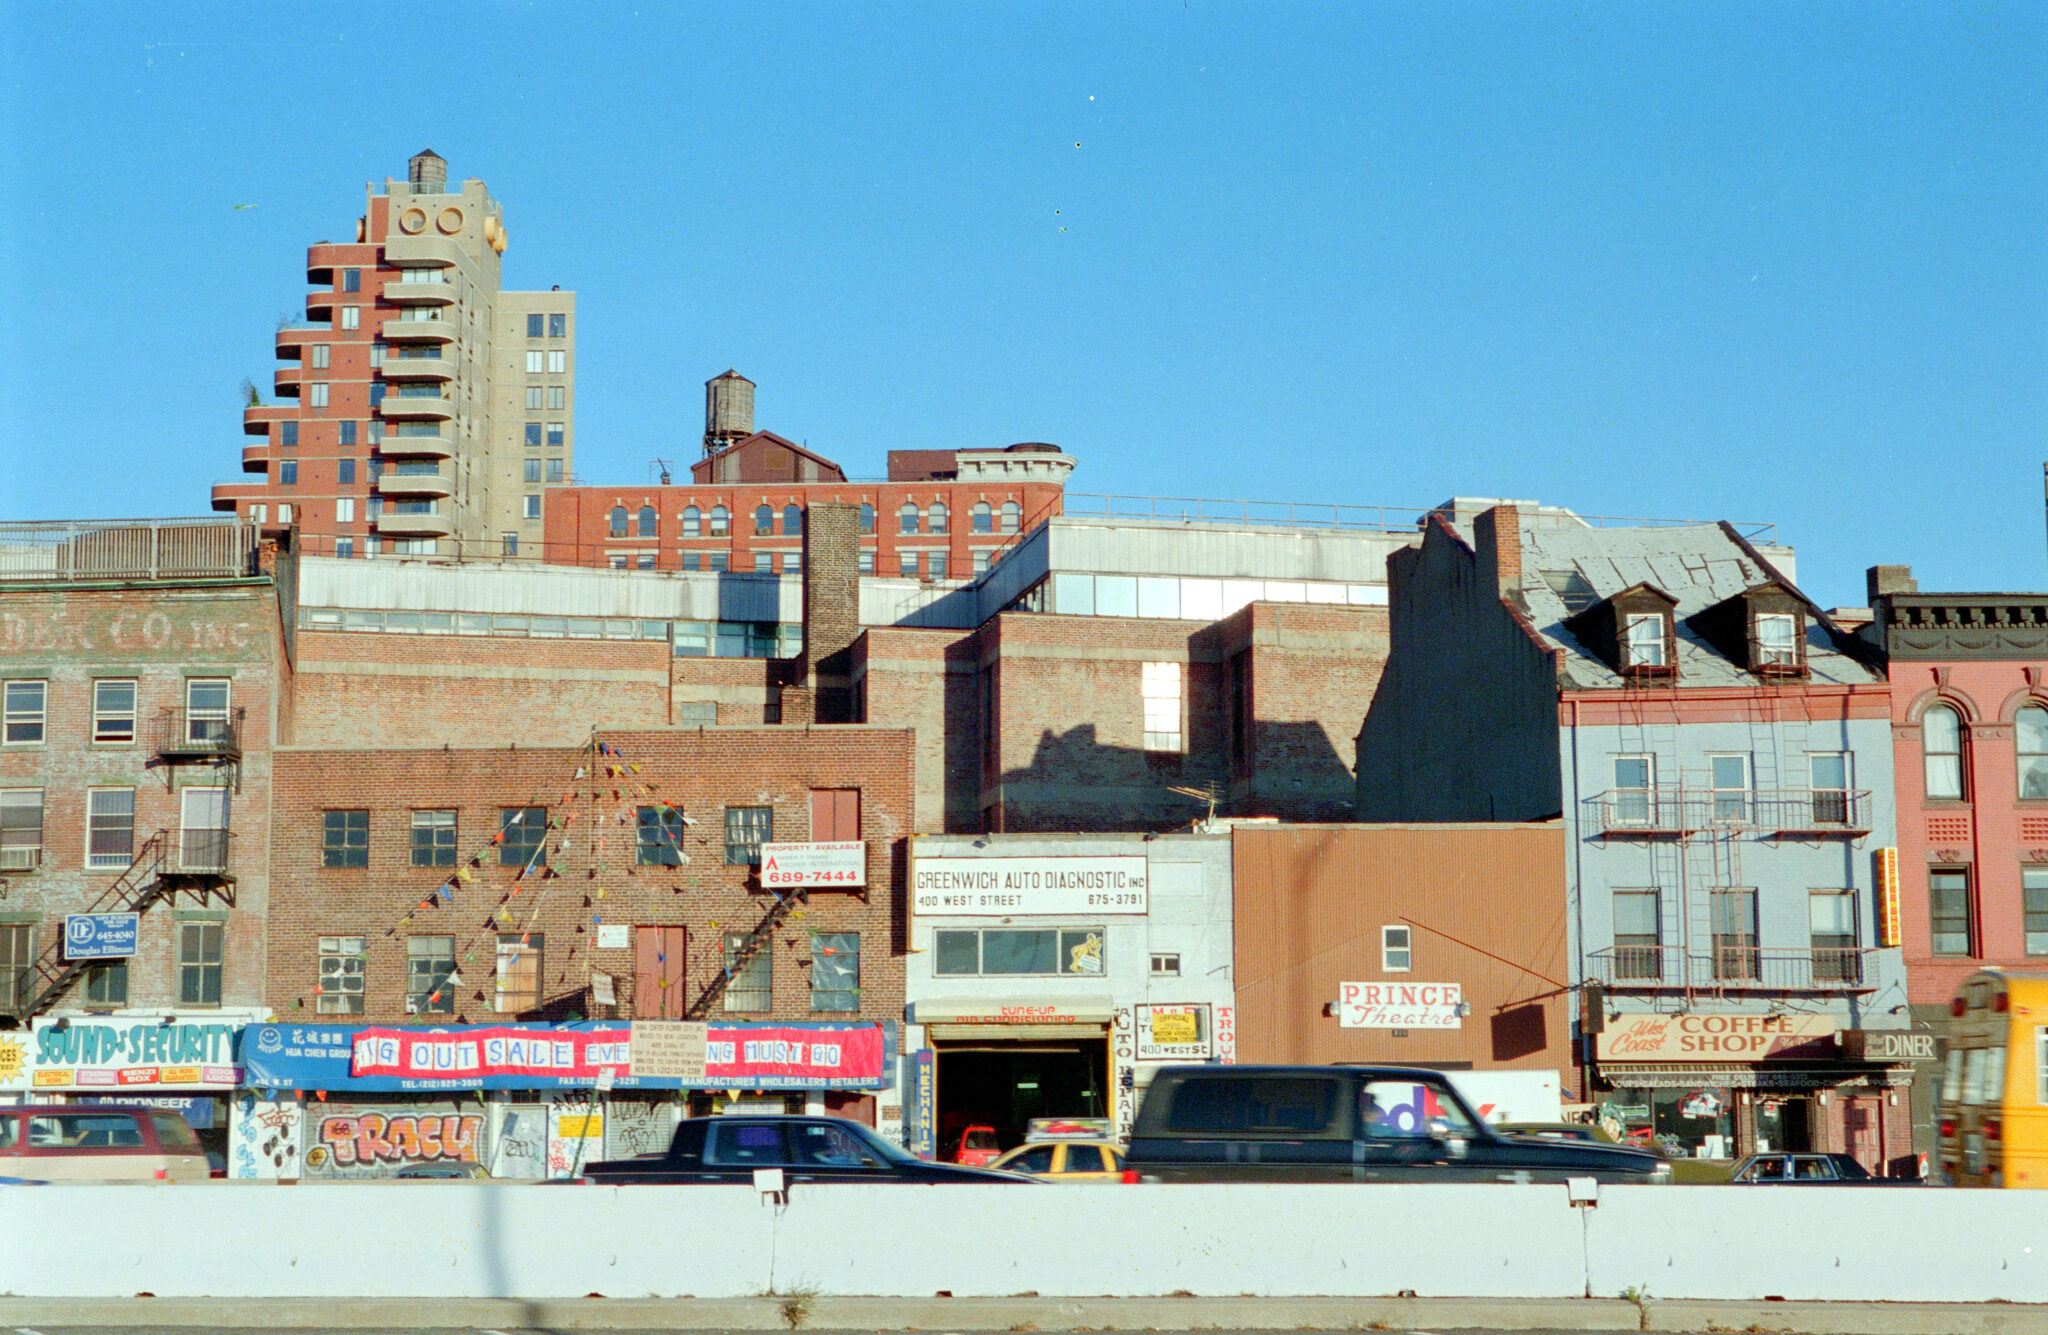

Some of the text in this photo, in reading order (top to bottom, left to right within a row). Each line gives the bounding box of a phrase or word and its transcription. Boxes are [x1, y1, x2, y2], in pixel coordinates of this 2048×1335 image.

[769, 870, 857, 883] 689-7444
[917, 871, 1145, 889] GREENWICH AUTO DIAGNOSTIC INC
[918, 894, 1023, 906] 400 WEST STREET
[1088, 894, 1143, 905] 675-3791
[1343, 985, 1459, 1006] PRINCE
[1352, 1004, 1455, 1026] Theatre
[1116, 1007, 1132, 1058] AUTO
[1629, 1016, 1793, 1037] West COFFEE
[36, 1024, 246, 1065] SOUND SECURITY
[285, 1047, 303, 1057] HUA
[304, 1048, 327, 1058] CHEN
[415, 1045, 474, 1068] OUT
[489, 1039, 570, 1065] SALE
[745, 1042, 804, 1062] MUST
[813, 1044, 839, 1065] GO
[1141, 1044, 1161, 1055] 400
[1609, 1032, 1767, 1056] Coast SHOP
[1885, 1034, 1934, 1057] DINER
[681, 1076, 879, 1087] MANUFACTURES WHOLESALERS RETAILERS
[117, 1098, 192, 1109] PIONEER
[920, 1063, 931, 1152] MECHANIC
